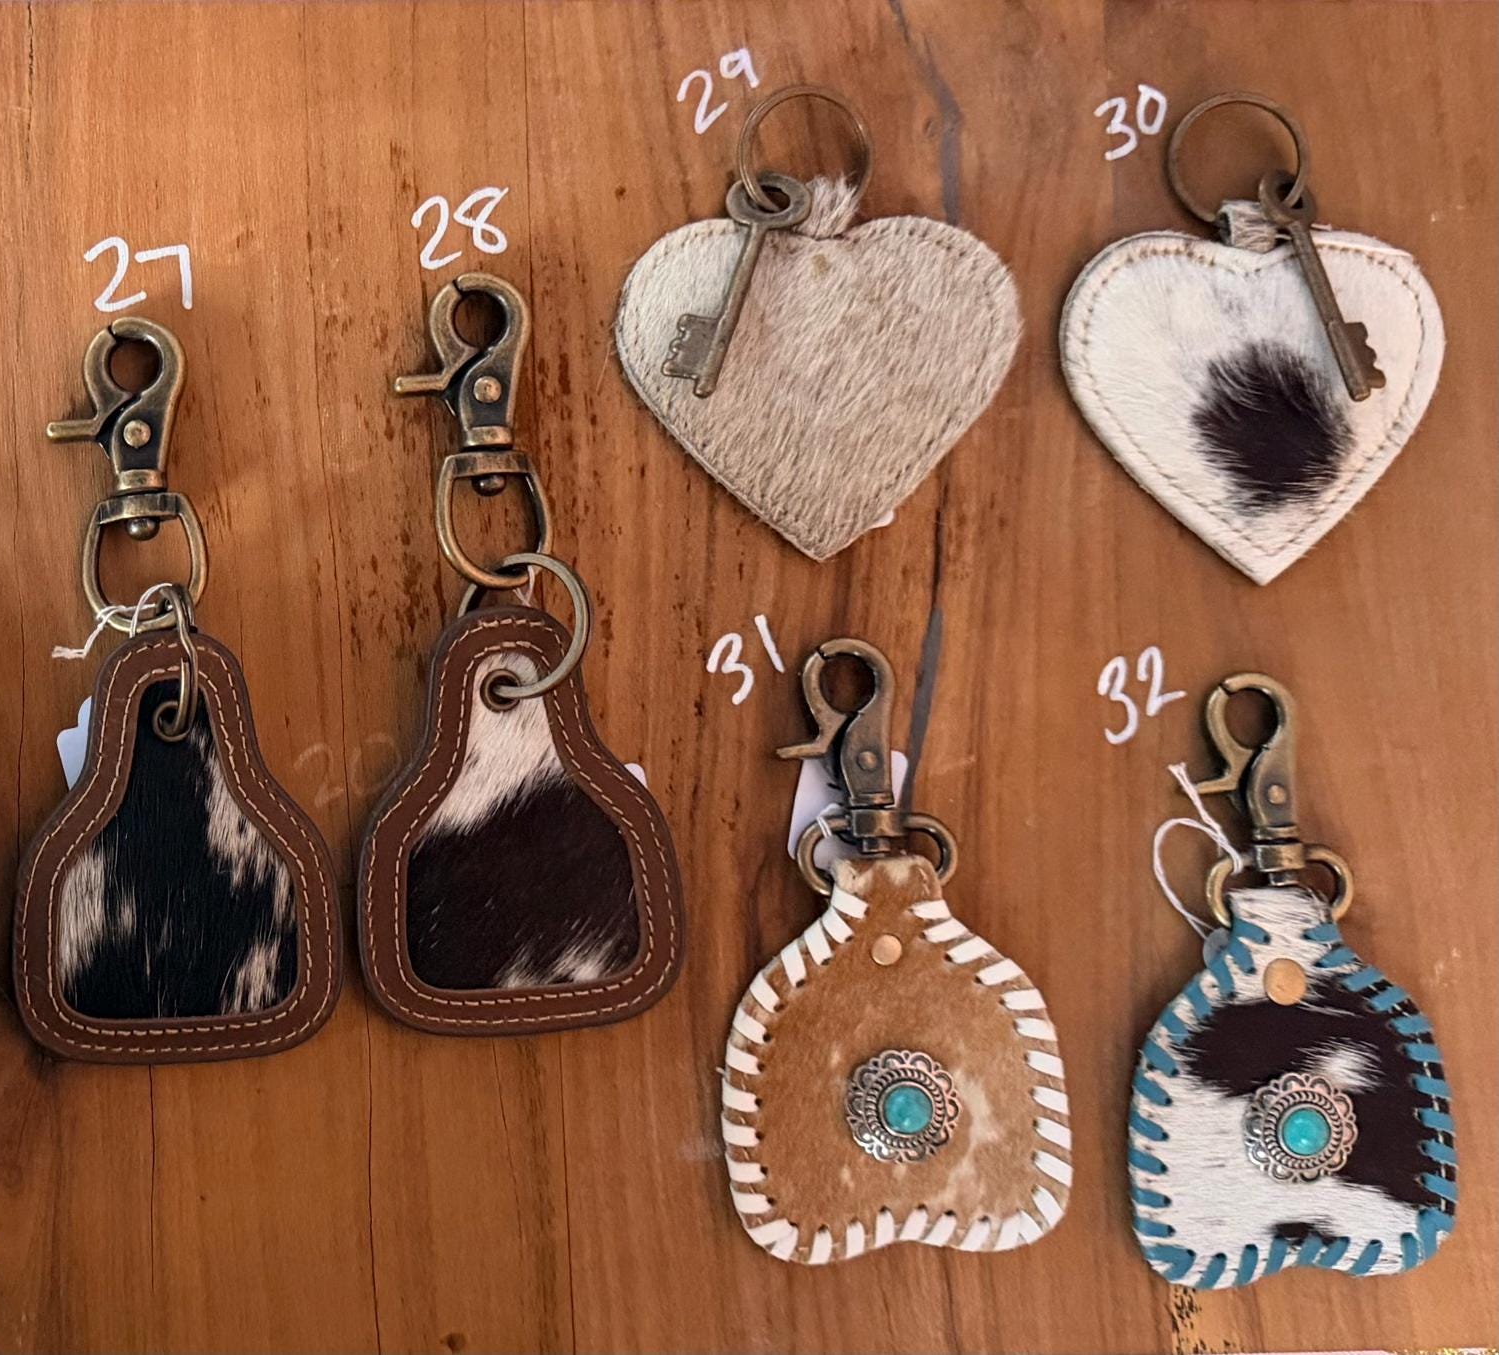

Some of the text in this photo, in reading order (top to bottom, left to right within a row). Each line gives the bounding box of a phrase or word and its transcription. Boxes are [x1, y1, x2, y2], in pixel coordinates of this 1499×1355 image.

[675, 46, 762, 135] 29
[1094, 84, 1168, 161] 30
[411, 186, 510, 271] 28
[84, 236, 193, 313] 27
[706, 614, 785, 706] 31
[1097, 645, 1187, 745] 32
